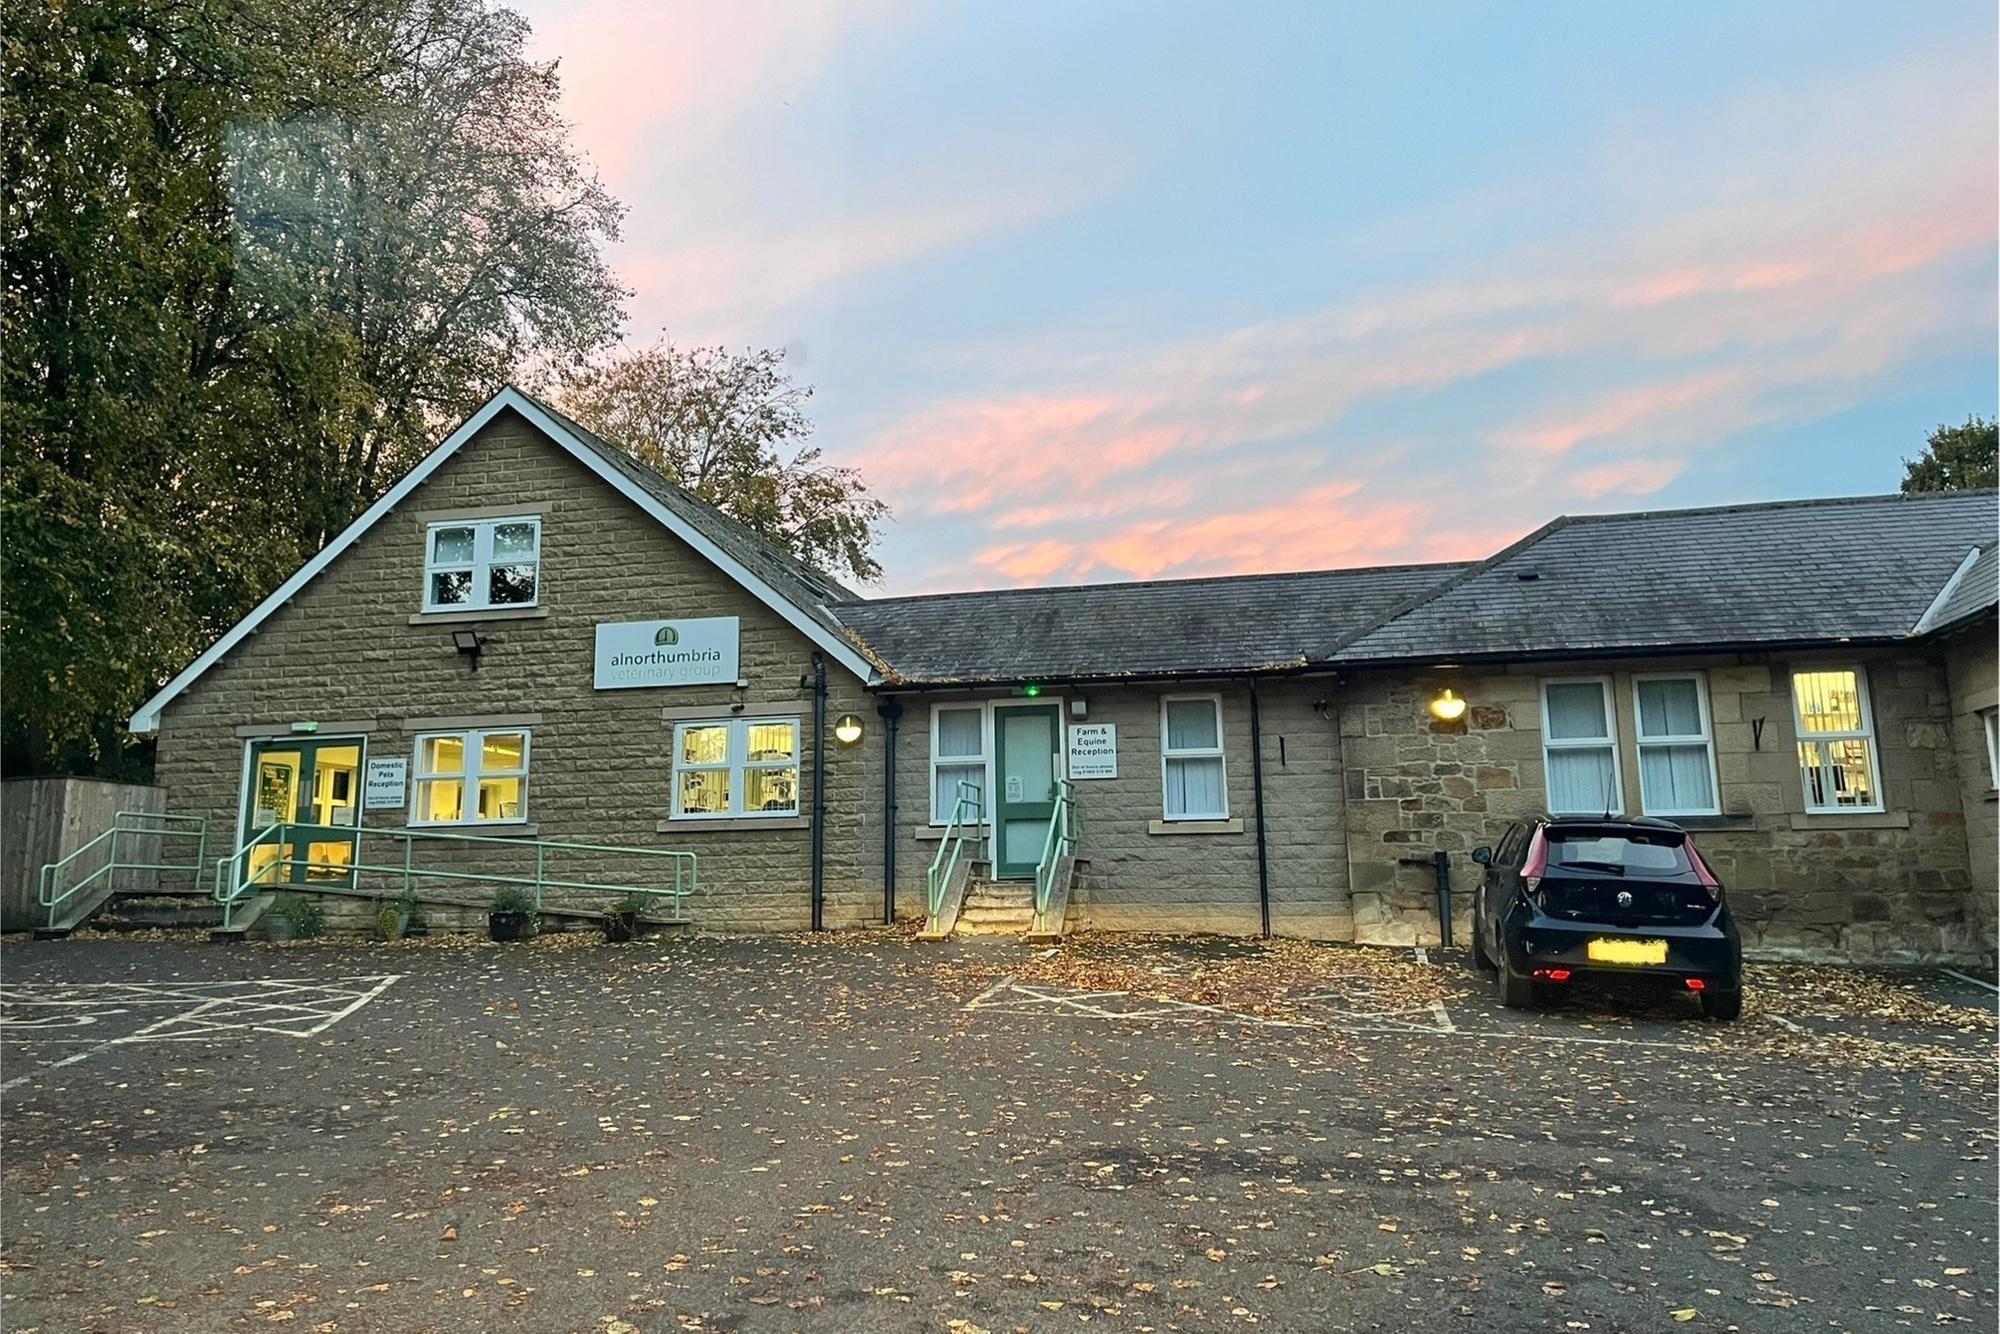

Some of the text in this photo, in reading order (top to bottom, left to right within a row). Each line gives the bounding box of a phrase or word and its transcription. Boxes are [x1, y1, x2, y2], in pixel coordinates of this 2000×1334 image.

[611, 648, 720, 666] alnorthumbria
[611, 665, 720, 681] veterinary group
[1078, 738, 1107, 746] Equine
[1071, 747, 1114, 756] Reception
[370, 761, 404, 769] Domestic
[368, 780, 404, 788] Reception
